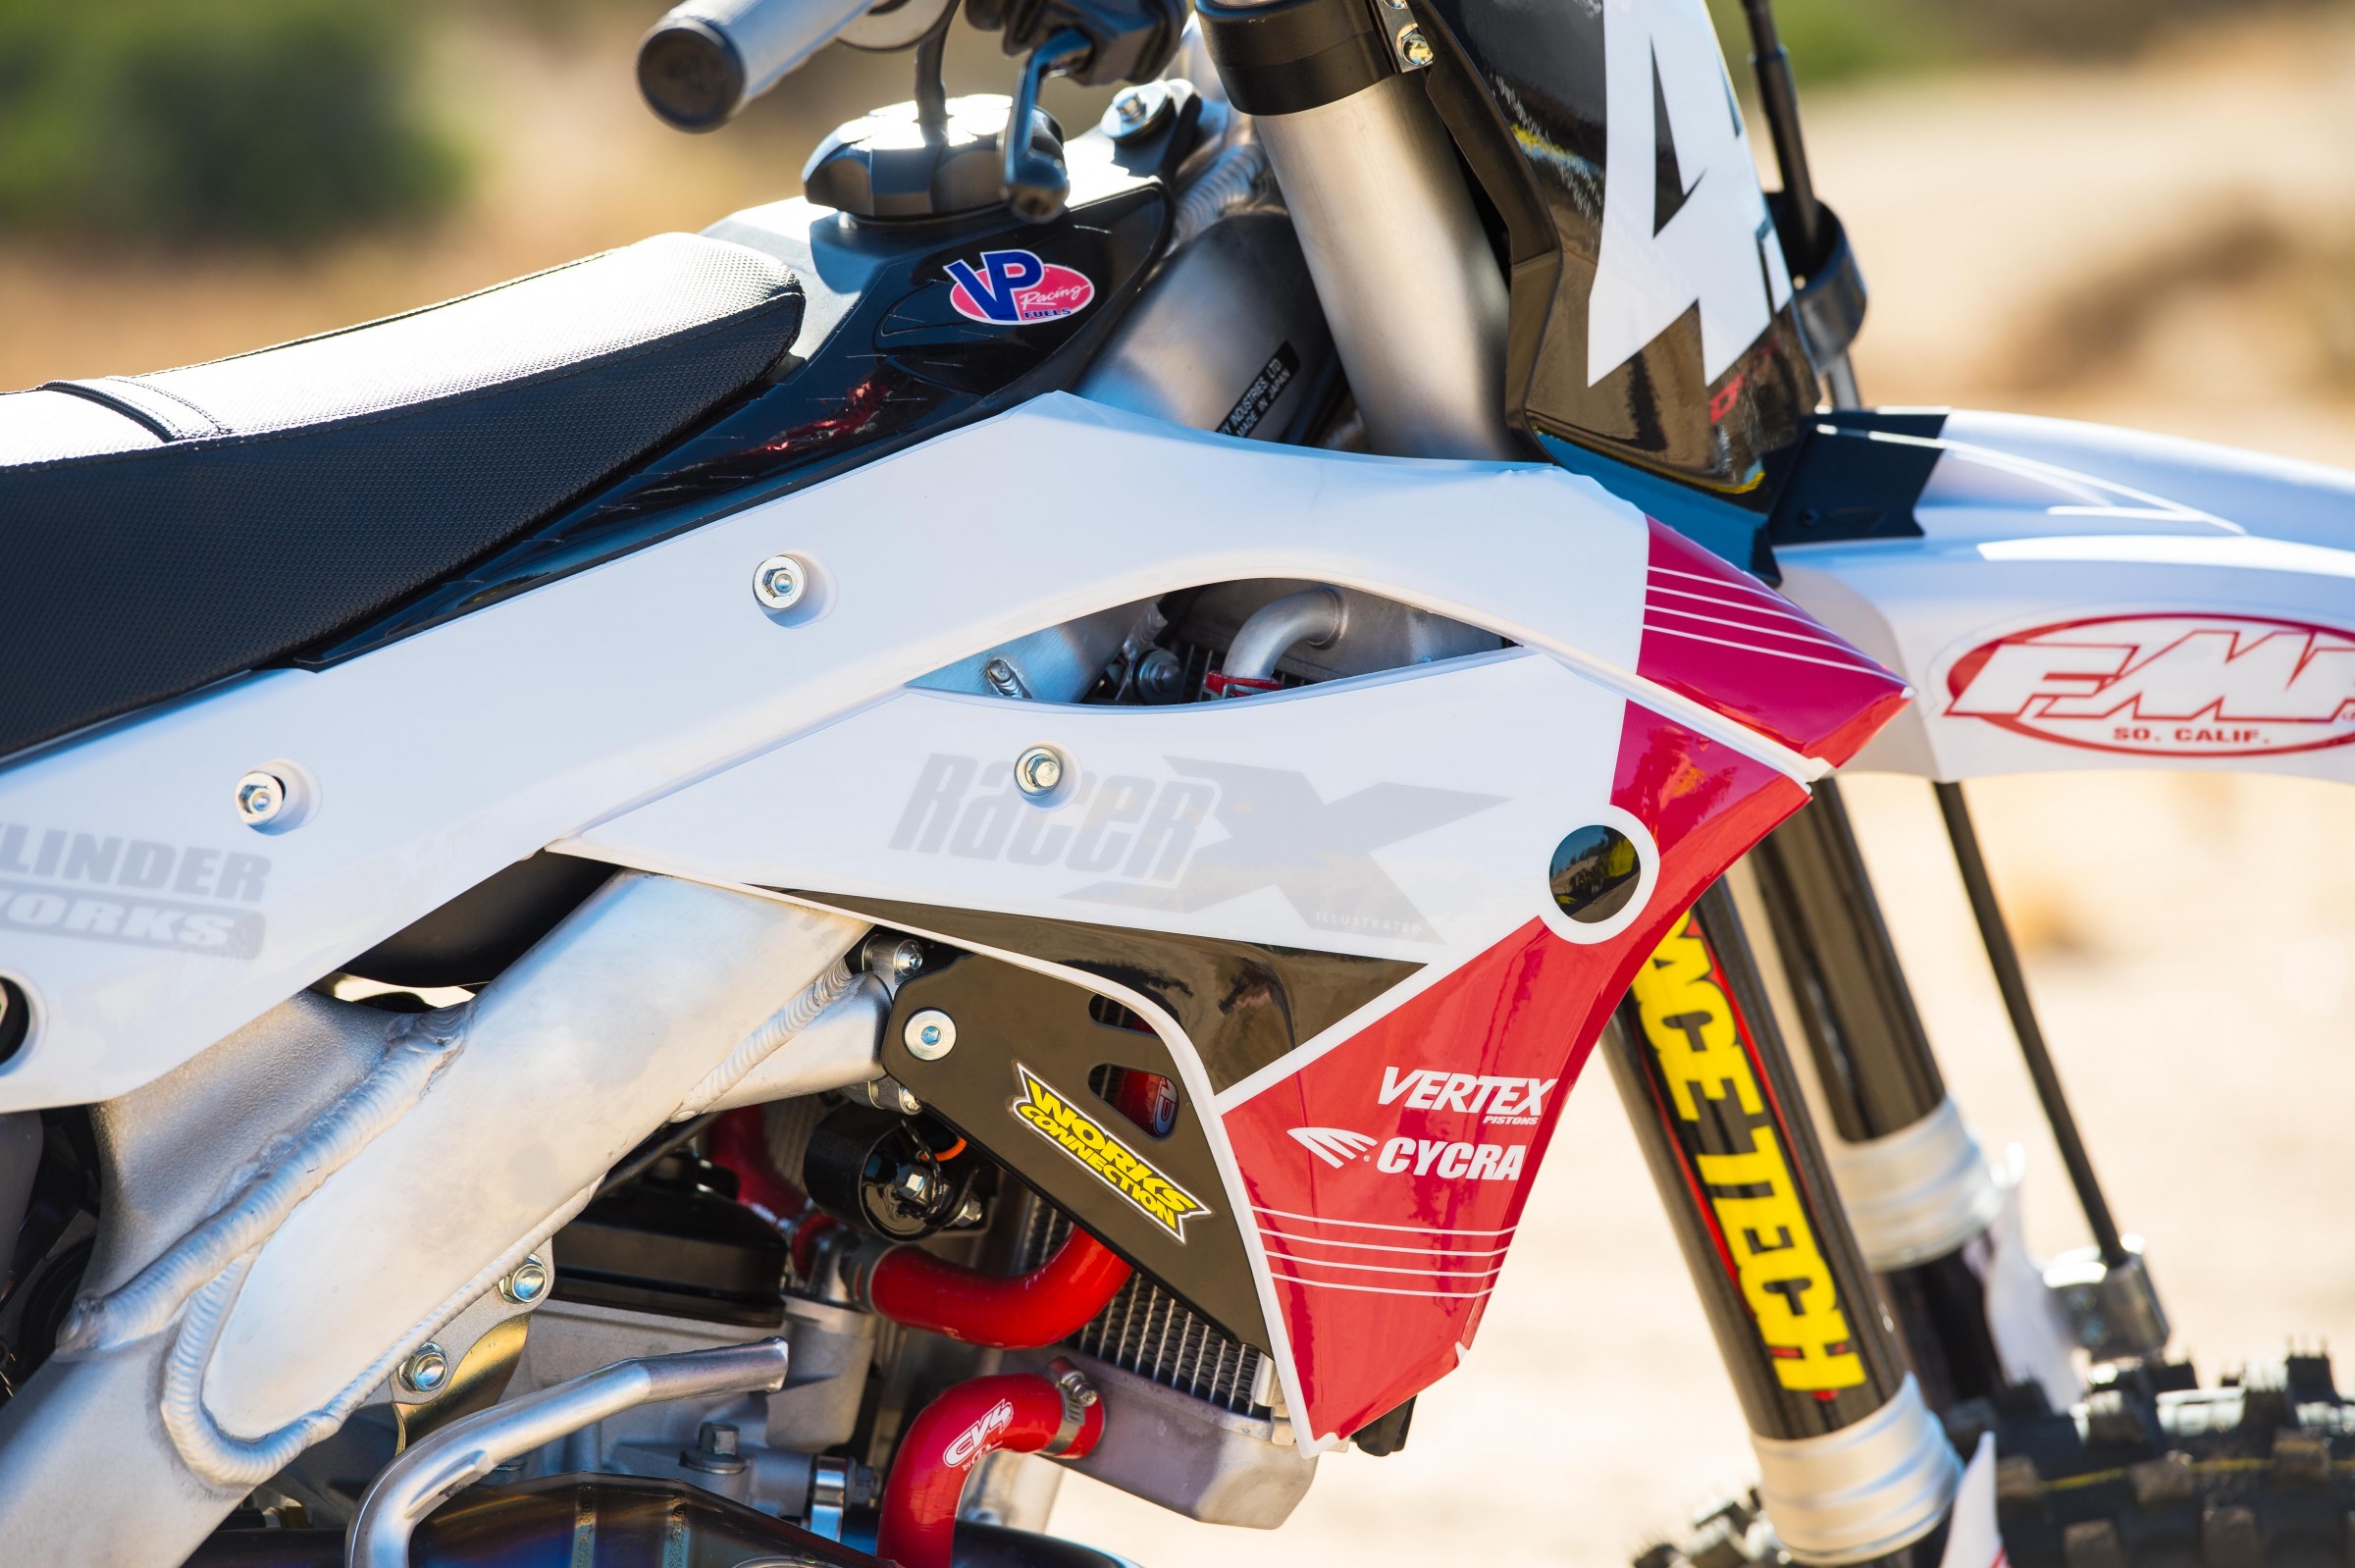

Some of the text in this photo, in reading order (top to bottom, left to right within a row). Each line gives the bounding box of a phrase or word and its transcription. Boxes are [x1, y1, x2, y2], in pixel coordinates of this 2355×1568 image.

[944, 249, 1044, 321] VP
[1020, 285, 1091, 310] Racing
[1024, 308, 1072, 319] FUELS
[1268, 368, 1291, 399] JAPAN
[0, 822, 273, 903] LINDER
[1314, 911, 1422, 934] ILLUSTRATED
[1378, 1066, 1558, 1116] VERTEX
[1483, 1115, 1540, 1125] PISTONS
[1020, 1105, 1177, 1228] CONNECTION
[1028, 1078, 1197, 1212] WORKS
[1377, 1136, 1528, 1181] CYCRA
[943, 1398, 1014, 1468] CV4
